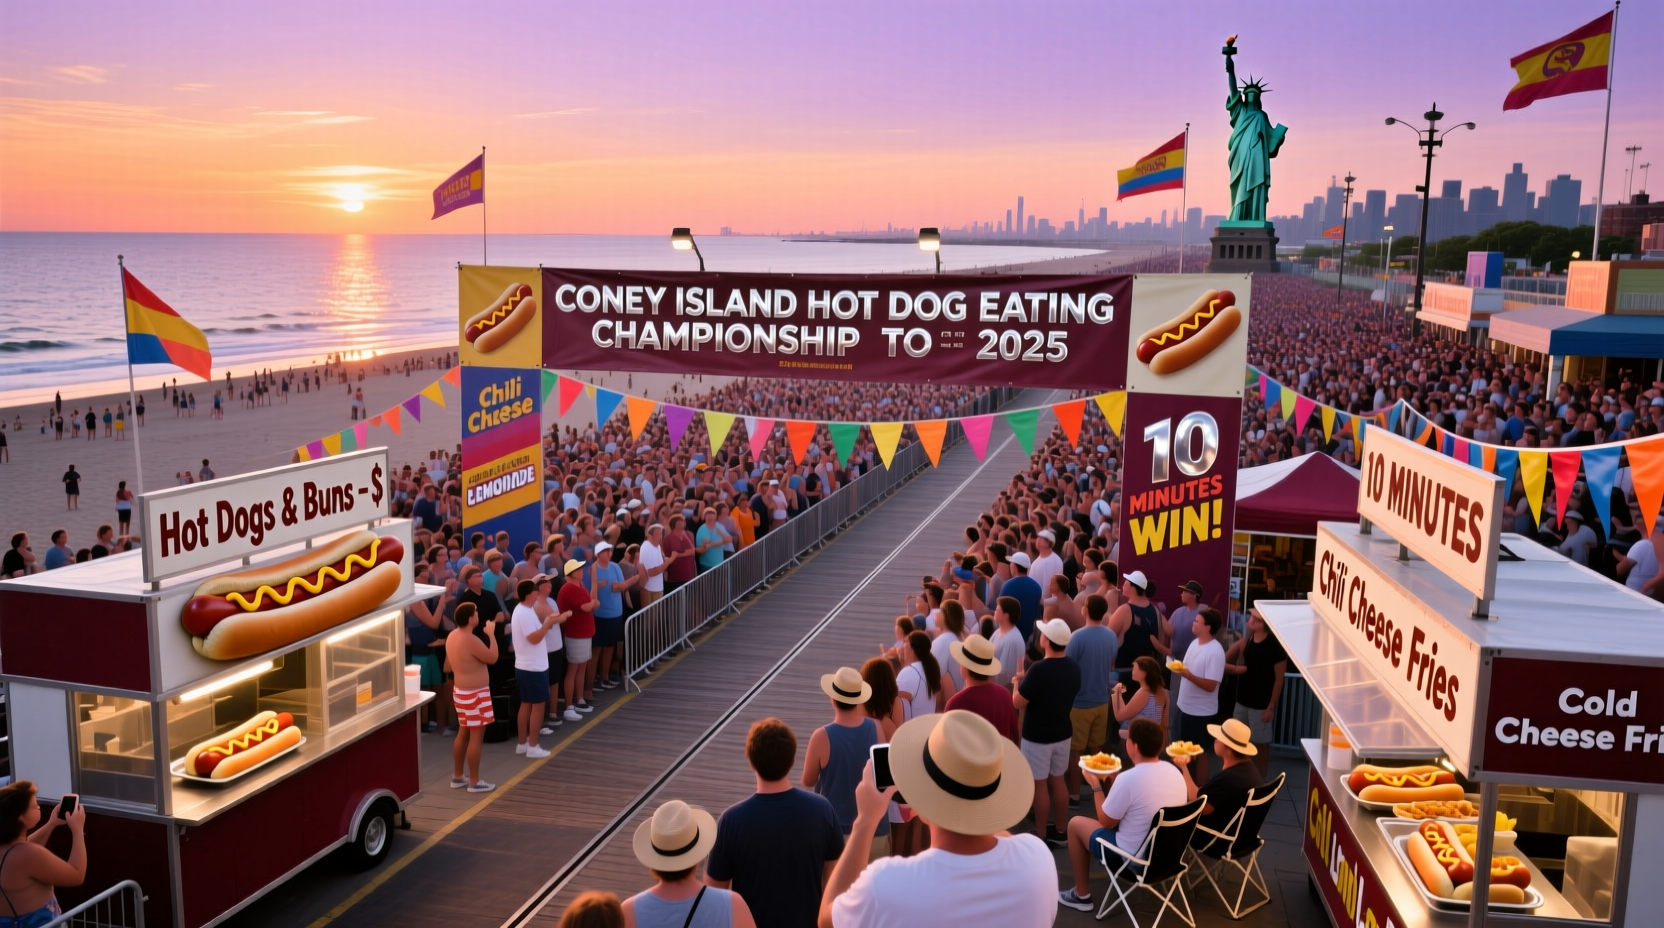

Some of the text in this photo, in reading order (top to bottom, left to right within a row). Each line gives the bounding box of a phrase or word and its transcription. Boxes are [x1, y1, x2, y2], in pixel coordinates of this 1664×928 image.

[555, 283, 1114, 324] CONEY ISLAND HOT DOG EATING
[591, 318, 860, 356] CHAMPIONSHIP
[882, 327, 932, 358] TO
[976, 329, 1068, 362] 2025
[479, 375, 521, 408] Chili
[1143, 410, 1219, 484] 10
[1129, 474, 1223, 515] MINUTES
[1366, 451, 1484, 564] 10 MINUTES
[159, 508, 209, 558] Hot
[216, 499, 276, 546] Dogs
[281, 486, 298, 526] &
[303, 481, 355, 521] Buns
[1129, 498, 1223, 556] WIN!
[1319, 549, 1460, 722] Chili Cheese Fries
[1558, 687, 1638, 718] Cold
[1494, 716, 1616, 750] Cheese
